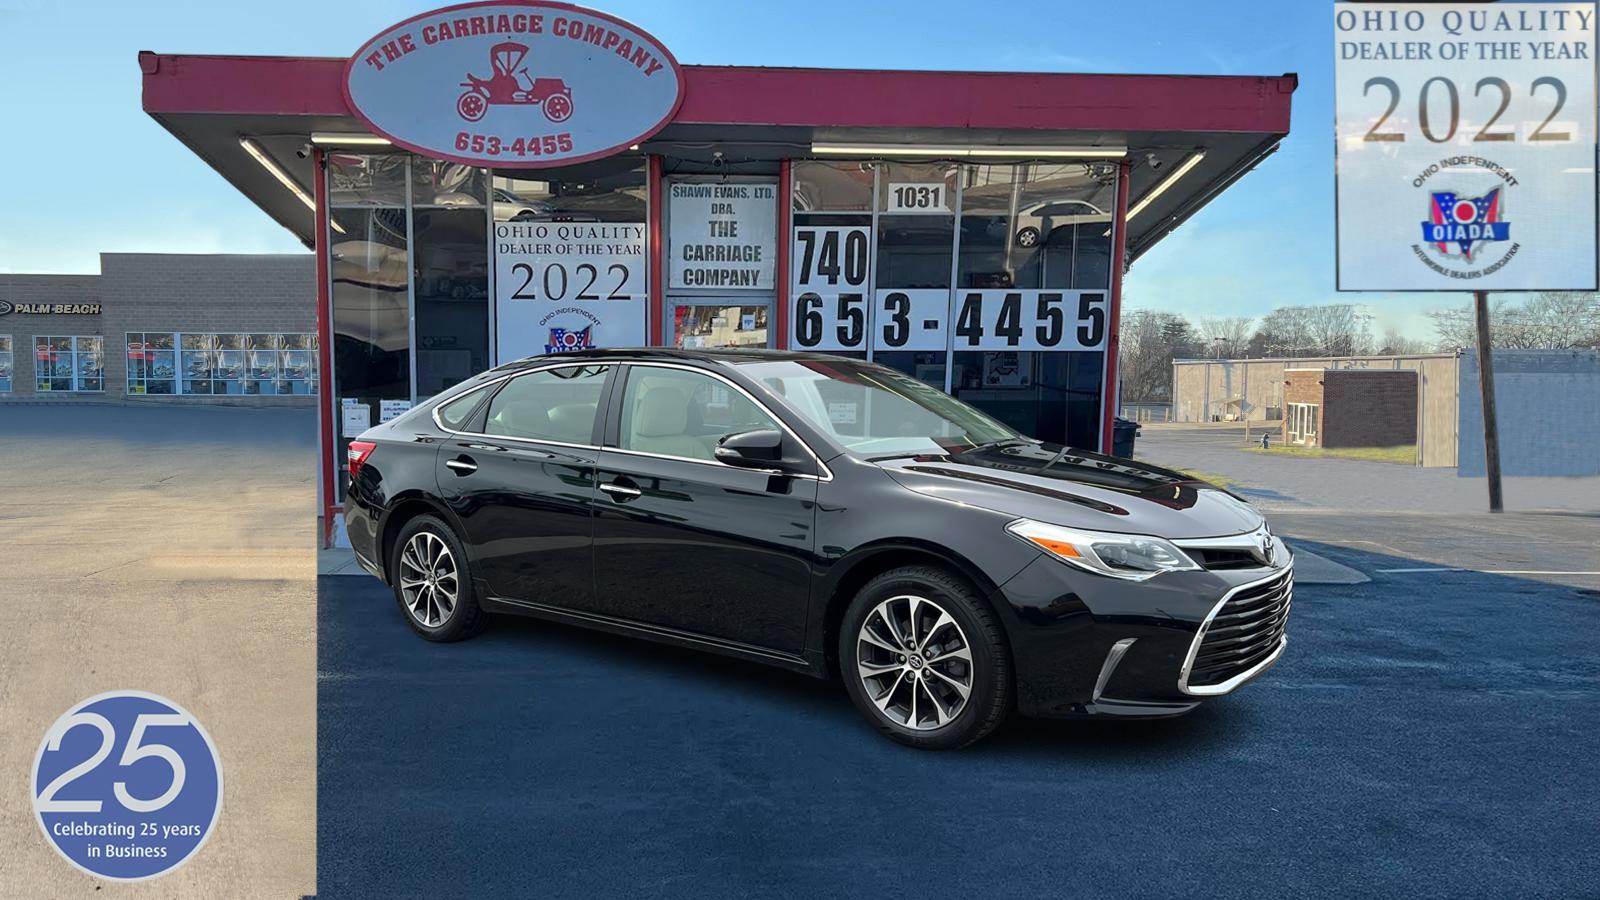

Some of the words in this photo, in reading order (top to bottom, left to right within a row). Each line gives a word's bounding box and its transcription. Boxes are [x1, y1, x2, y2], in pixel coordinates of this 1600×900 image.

[1336, 10, 1425, 31] OHIO
[1442, 10, 1593, 36] QUALITY
[365, 33, 417, 71] THE
[422, 14, 543, 46] CARRIAGE
[552, 16, 664, 77] COMPANY
[1340, 42, 1433, 60] DEALER
[1438, 42, 1469, 60] OF
[1475, 42, 1521, 60] THE
[1528, 42, 1589, 60] YEAR
[1363, 76, 1571, 143] 2022
[454, 132, 574, 157] 653-4455
[1412, 164, 1439, 188] OHIO
[1440, 156, 1519, 187] INDEPENDENT
[672, 186, 712, 198] SHAWN
[754, 187, 774, 199] LTD.
[894, 186, 941, 208] 1031
[711, 203, 736, 215] DBA.
[497, 226, 548, 239] OHIO
[557, 226, 644, 241] QUALITY
[708, 220, 738, 238] THE
[1432, 224, 1495, 240] OIADA
[499, 244, 552, 255] DEALER
[555, 244, 573, 255] OF
[576, 244, 603, 255] THE
[606, 244, 641, 255] YEAR
[683, 245, 762, 262] CARRIAGE
[796, 230, 868, 286] 740
[1411, 244, 1450, 277] AUTOMOBILE
[1450, 270, 1482, 279] DEALERS
[1482, 242, 1521, 276] ASSOCIATION
[510, 263, 632, 301] 2022
[683, 268, 760, 286] COMPANY
[14, 304, 51, 314] PALM
[55, 304, 101, 314] BEACH
[539, 312, 555, 327] OHIO
[555, 307, 602, 327] INDEPENDENT
